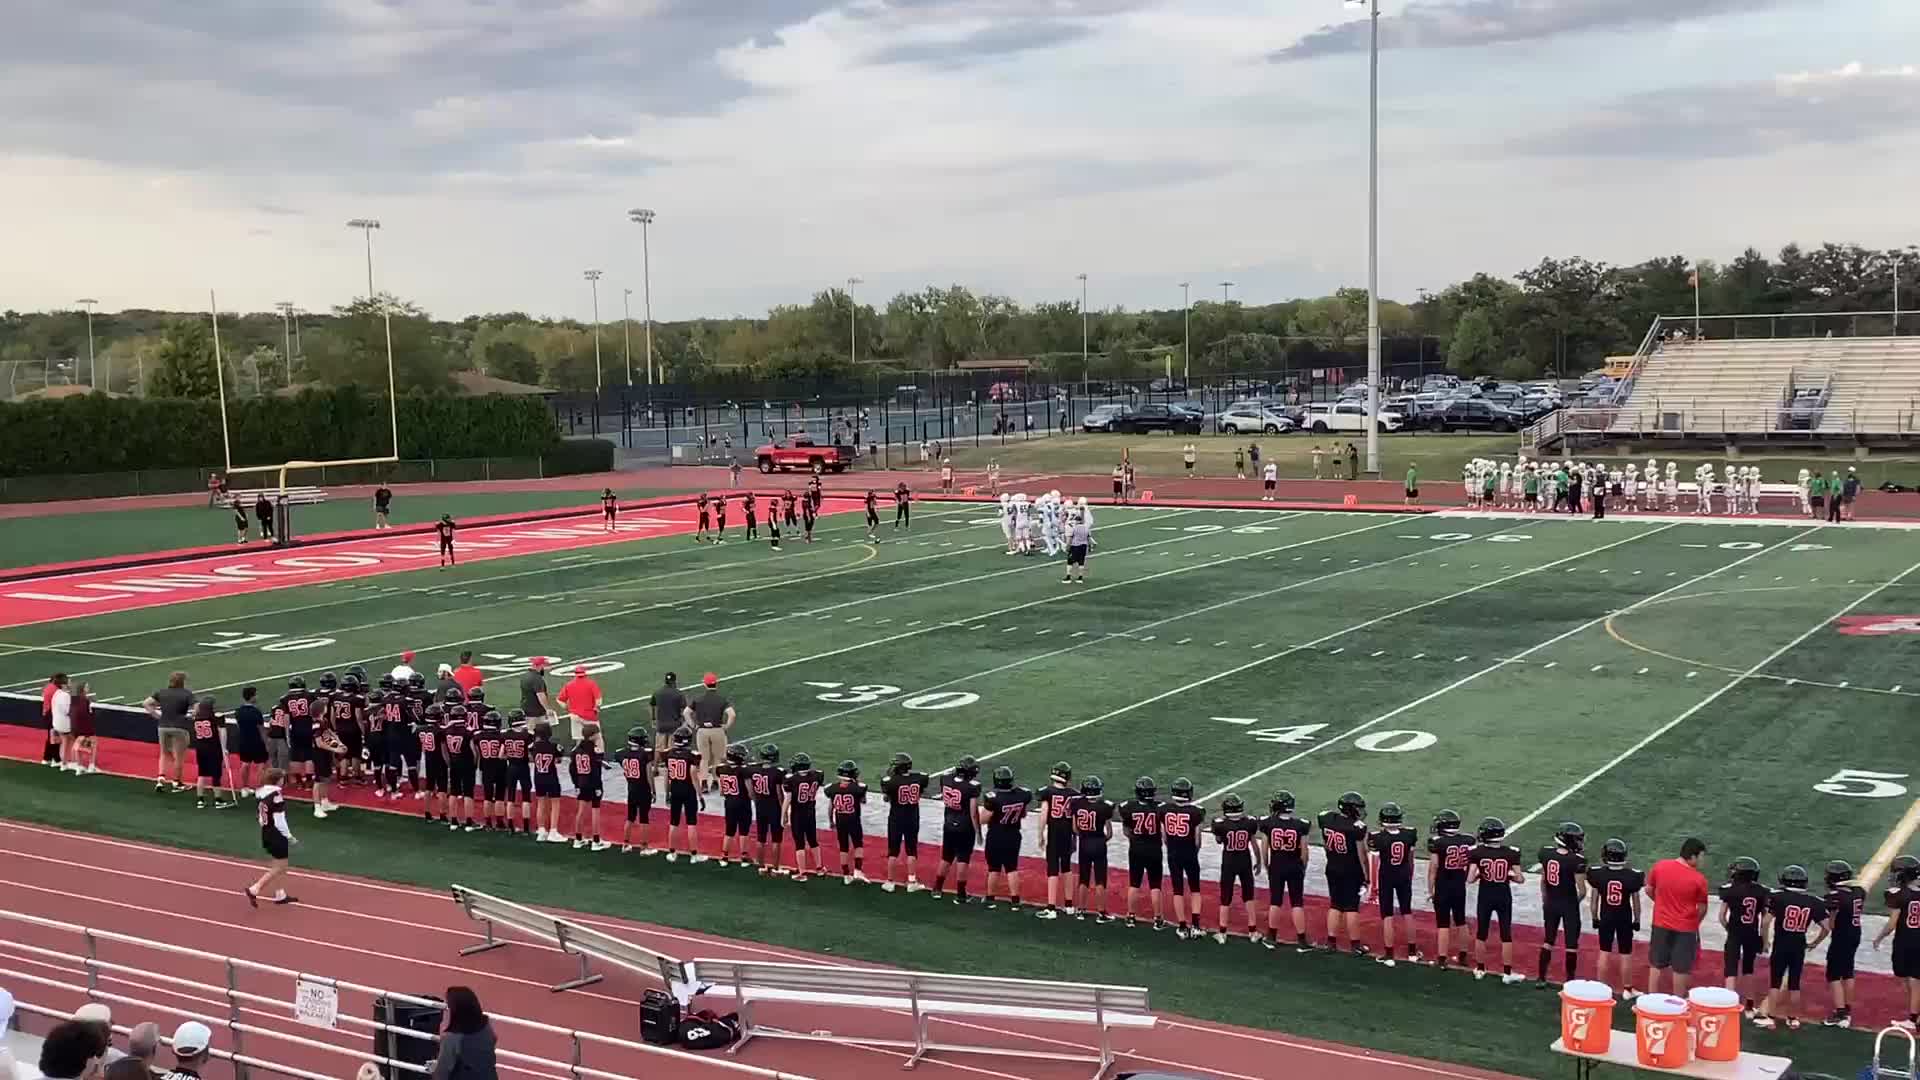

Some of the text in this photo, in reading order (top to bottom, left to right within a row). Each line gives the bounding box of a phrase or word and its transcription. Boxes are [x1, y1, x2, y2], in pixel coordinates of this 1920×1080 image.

[197, 633, 337, 651] 10
[815, 684, 981, 711] 30
[1245, 722, 1438, 752] 40
[668, 759, 688, 781] 50
[752, 773, 770, 795] 31
[797, 781, 818, 803] 64
[1813, 768, 1910, 798] 5
[833, 794, 855, 815] 42
[999, 801, 1026, 825] 77
[1051, 794, 1073, 819] 54
[1076, 808, 1097, 832] 21
[1131, 811, 1157, 835] 74
[1164, 812, 1191, 837] 65
[1226, 829, 1249, 852] 18
[1270, 827, 1298, 852] 63
[1323, 827, 1348, 854] 78
[1390, 841, 1405, 866] 9
[1479, 858, 1509, 883] 30
[1546, 859, 1560, 886] 8
[1606, 880, 1623, 906] 6
[1740, 897, 1758, 924] 3
[1782, 904, 1811, 932] 81
[310, 988, 325, 1000] NO
[1571, 1008, 1586, 1025] G
[1700, 1015, 1717, 1033] G
[1646, 1022, 1664, 1039] G
